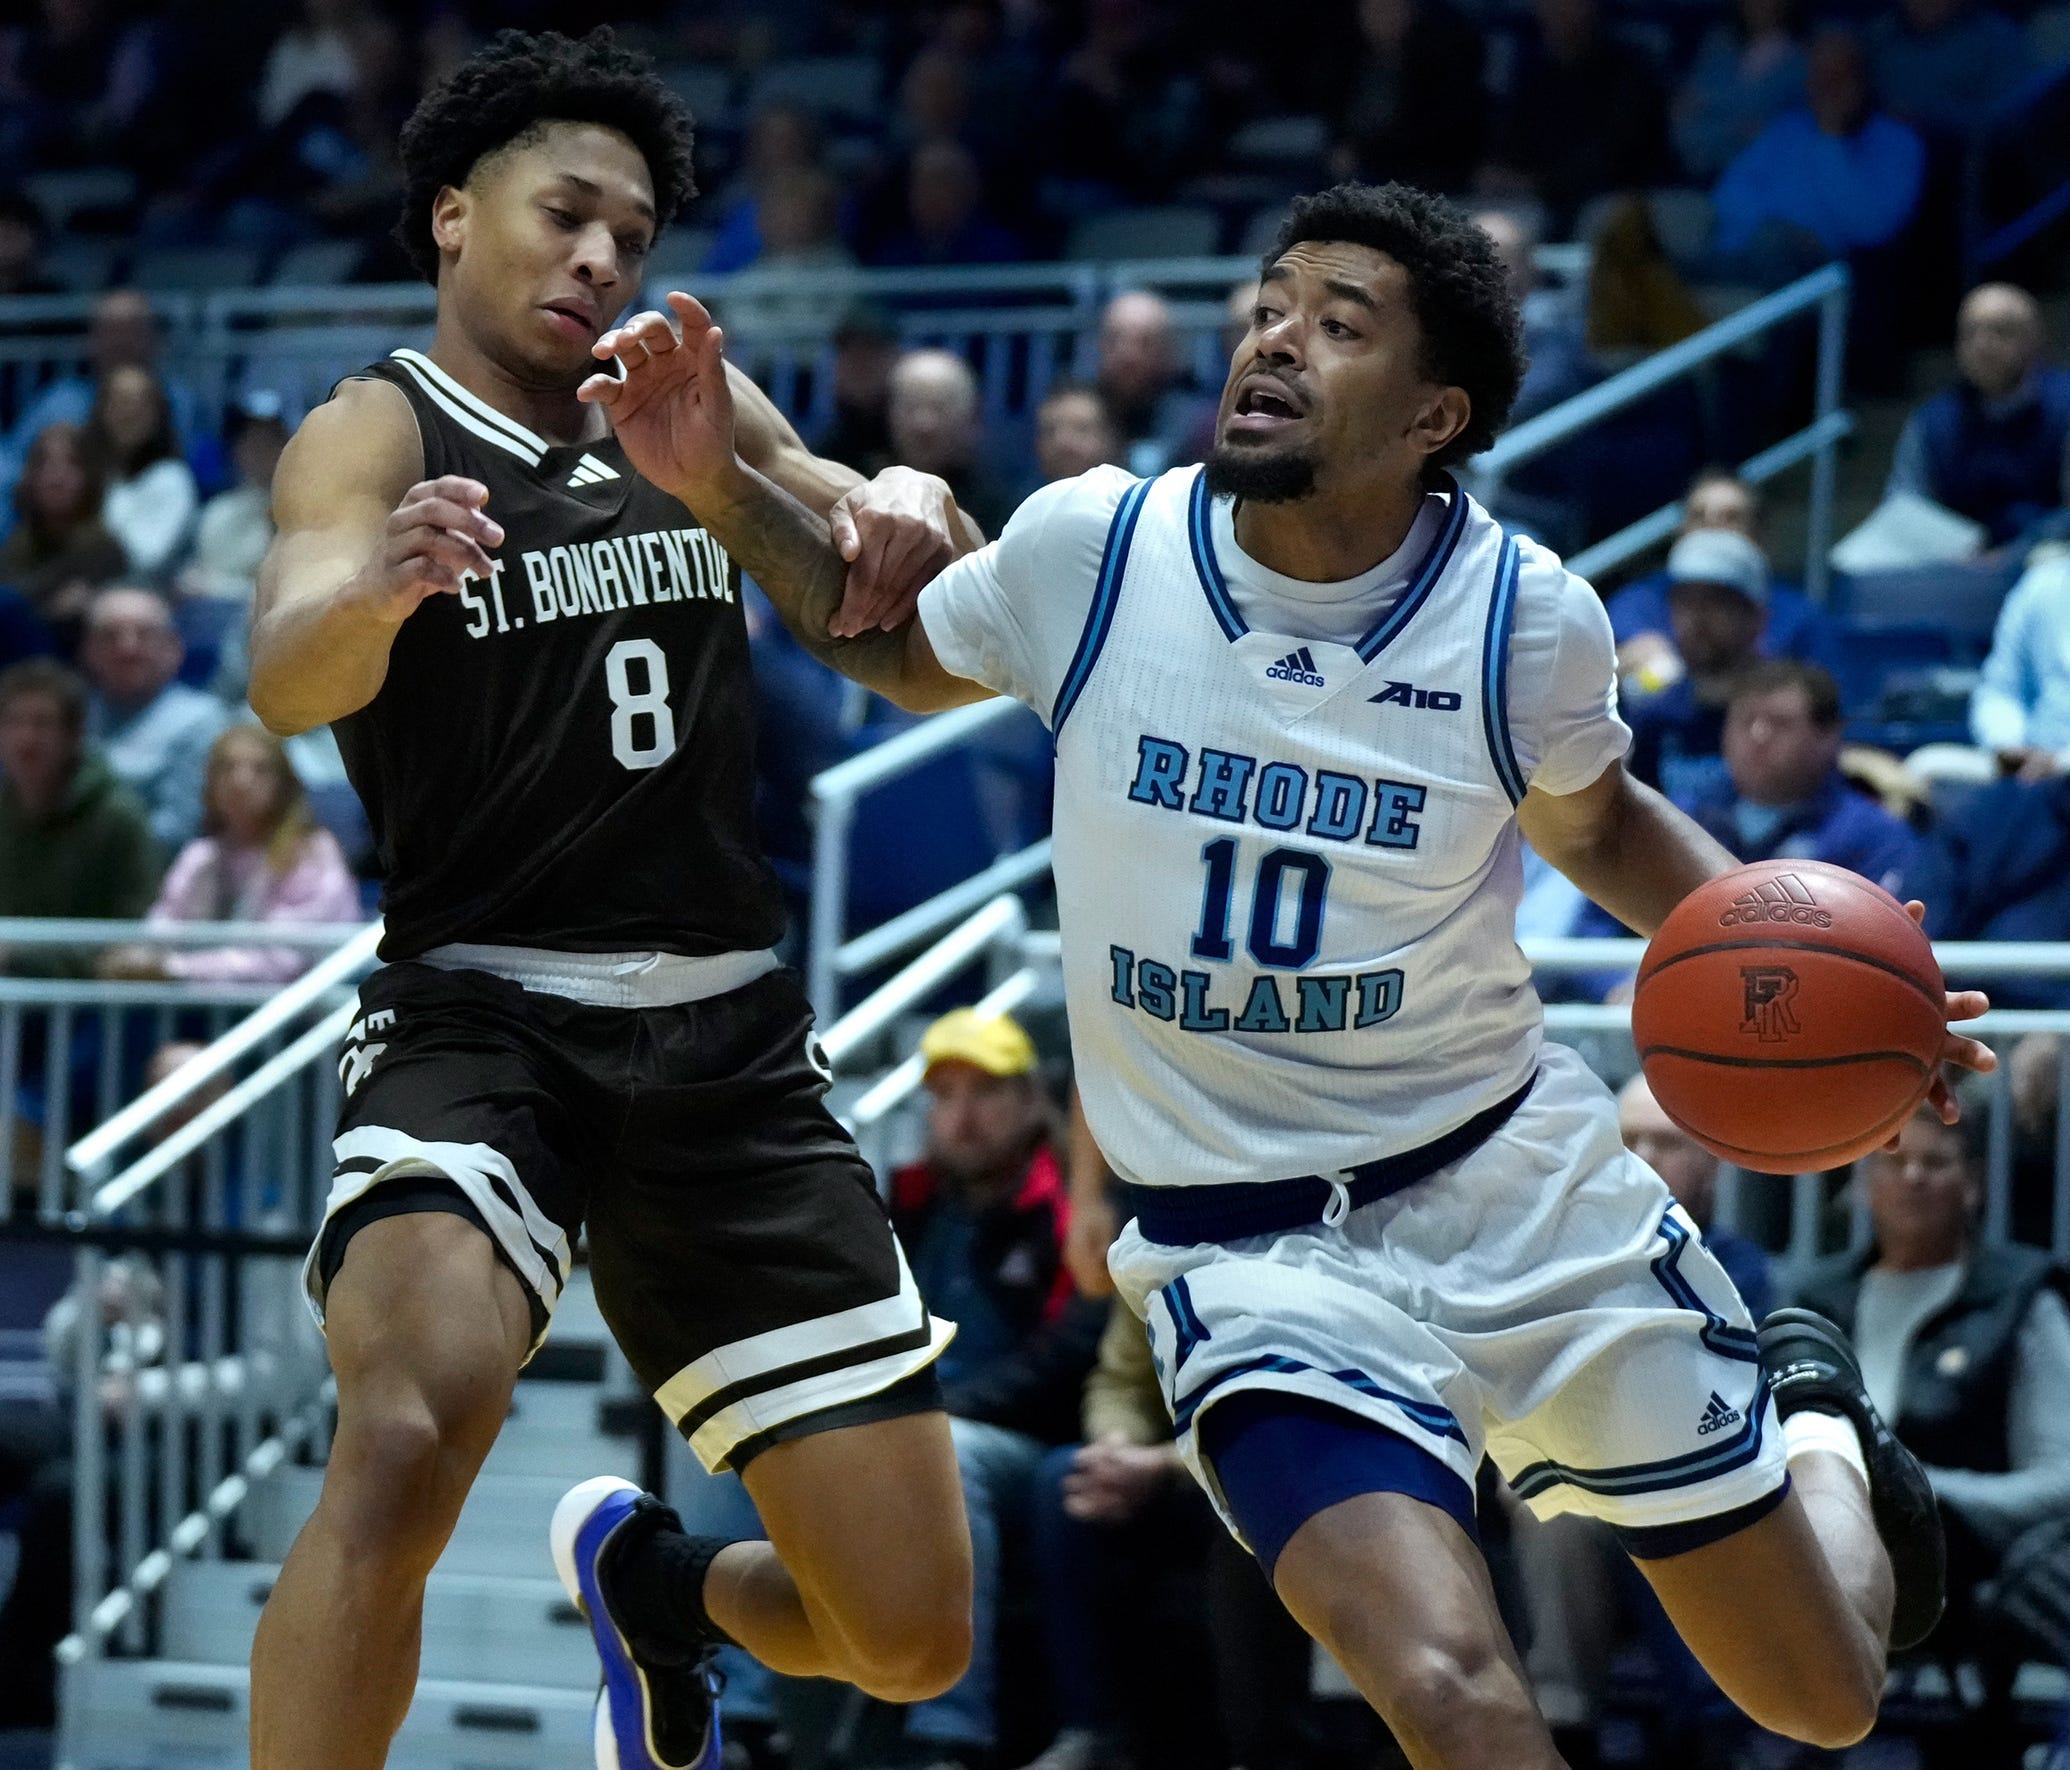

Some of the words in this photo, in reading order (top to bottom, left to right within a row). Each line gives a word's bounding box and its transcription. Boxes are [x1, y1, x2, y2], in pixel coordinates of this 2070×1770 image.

[460, 558, 525, 639] ST.
[605, 638, 677, 770] 8
[1266, 666, 1325, 688] adidas
[1366, 680, 1462, 712] A10
[1128, 735, 1428, 850] RHODE
[1190, 834, 1334, 971] 10
[1719, 901, 1833, 929] adidas
[1110, 944, 1405, 1033] ISLAND
[1697, 1409, 1741, 1436] adidas
